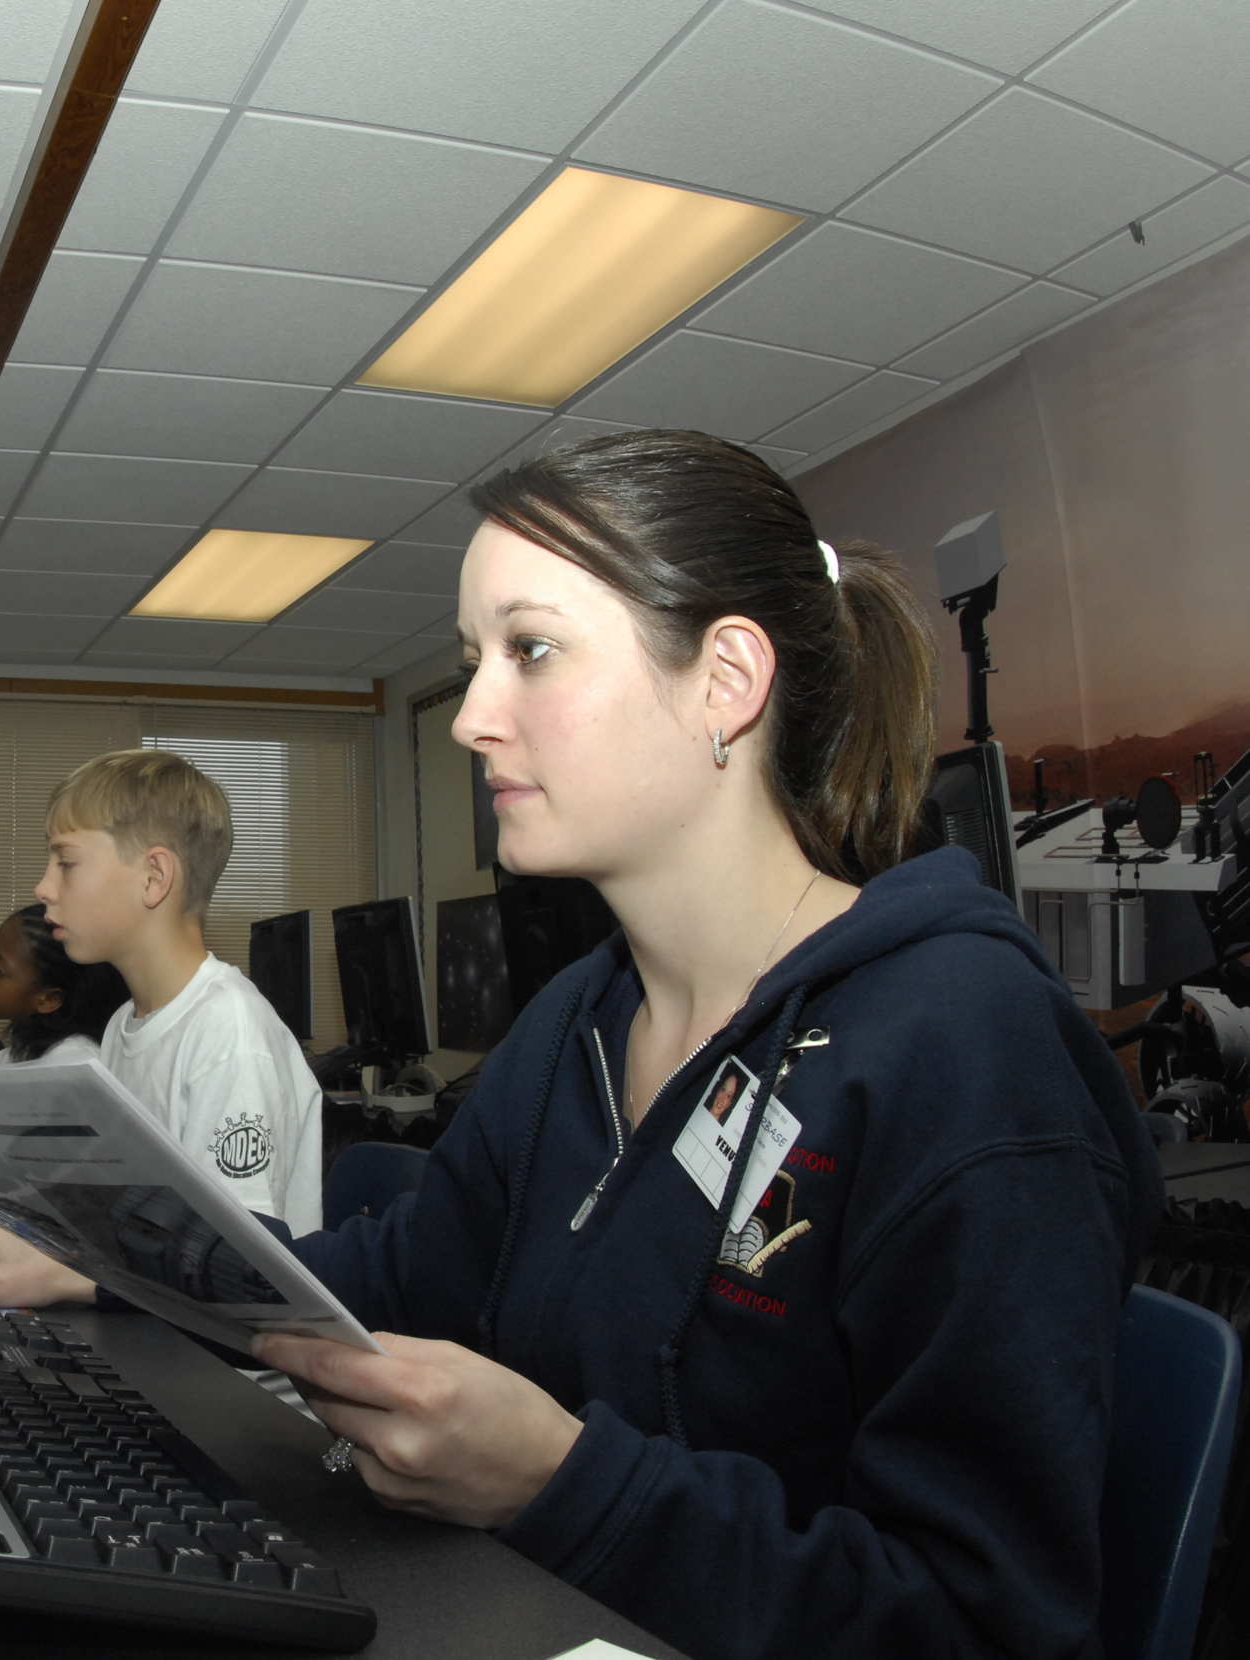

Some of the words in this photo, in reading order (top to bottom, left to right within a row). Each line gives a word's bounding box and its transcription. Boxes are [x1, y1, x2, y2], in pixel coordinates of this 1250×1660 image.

[745, 1102, 788, 1148] SRBASE
[223, 1128, 266, 1168] MDEC
[715, 1134, 737, 1163] VENU
[787, 1147, 835, 1173] CATION
[709, 1274, 786, 1317] SOCIATION
